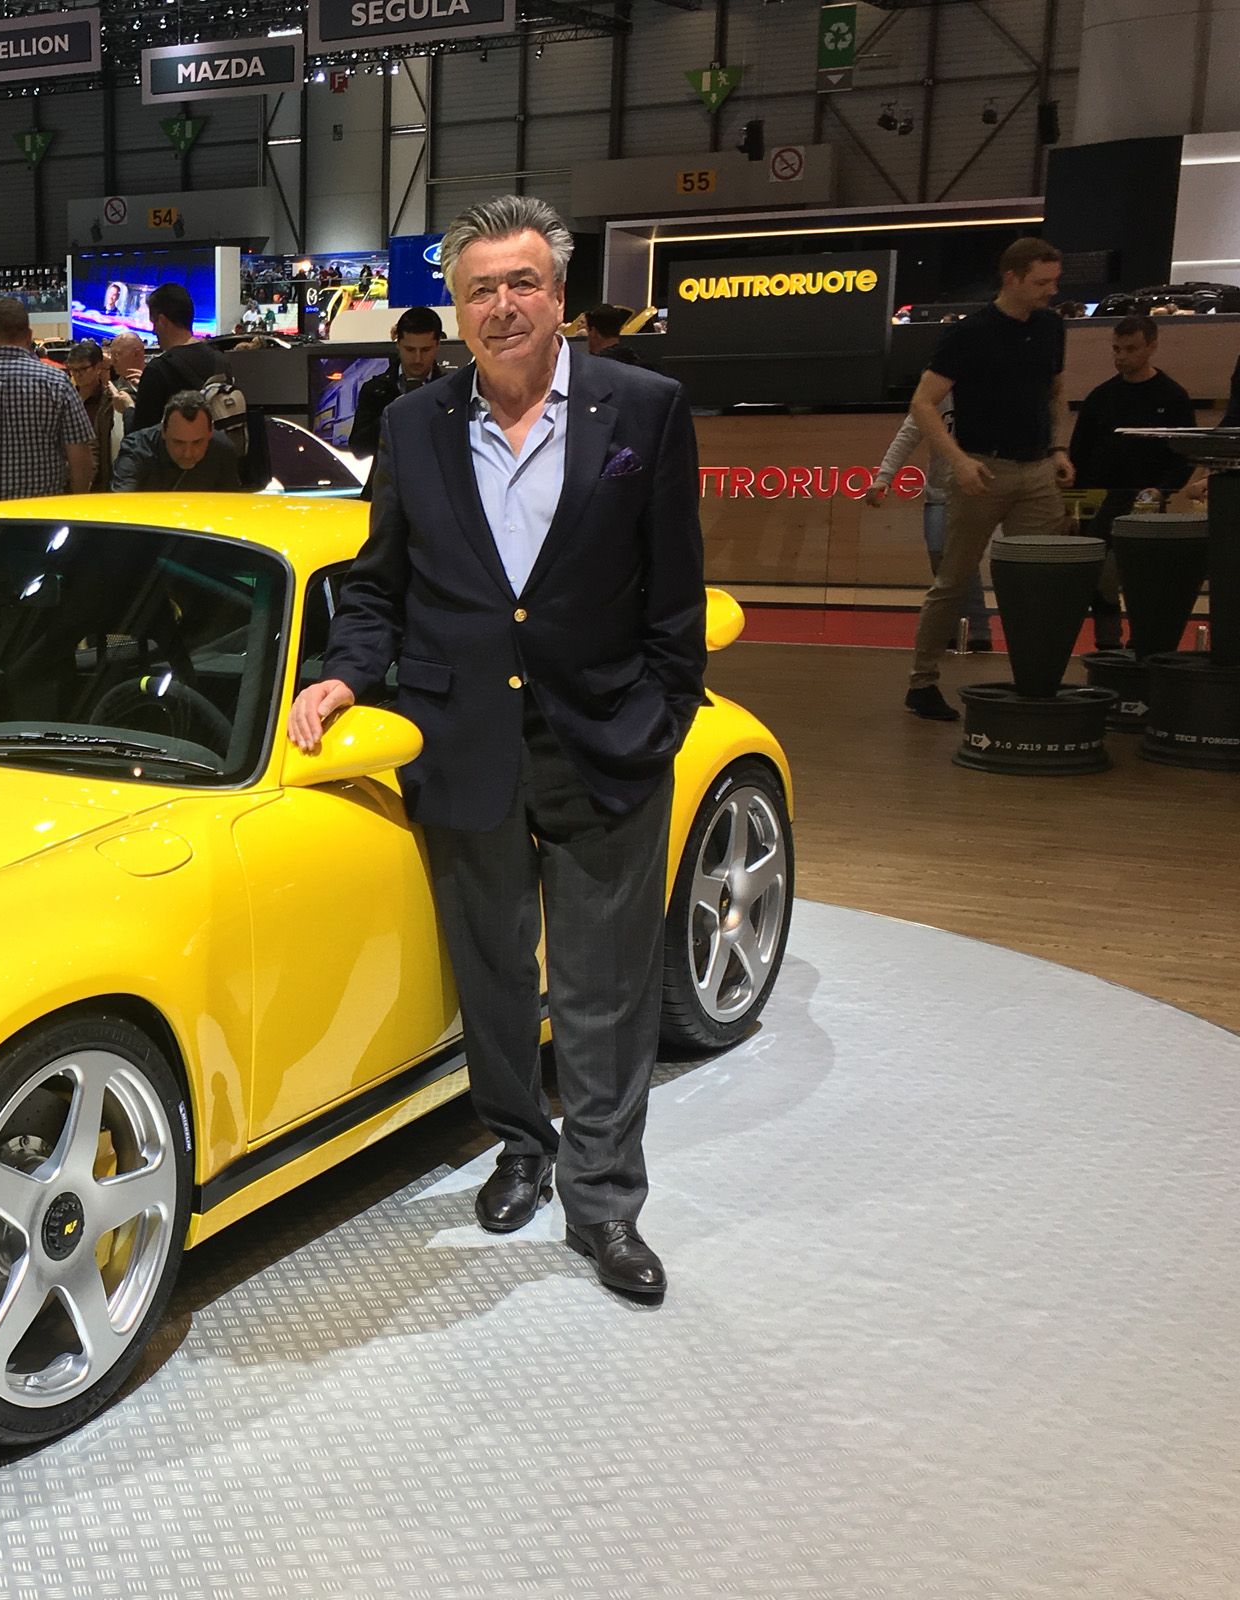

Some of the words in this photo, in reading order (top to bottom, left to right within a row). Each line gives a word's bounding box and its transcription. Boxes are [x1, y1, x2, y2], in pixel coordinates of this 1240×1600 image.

[351, 0, 470, 27] SEGULA
[177, 56, 266, 84] MAZDA
[682, 172, 710, 192] 55
[152, 208, 173, 227] 54
